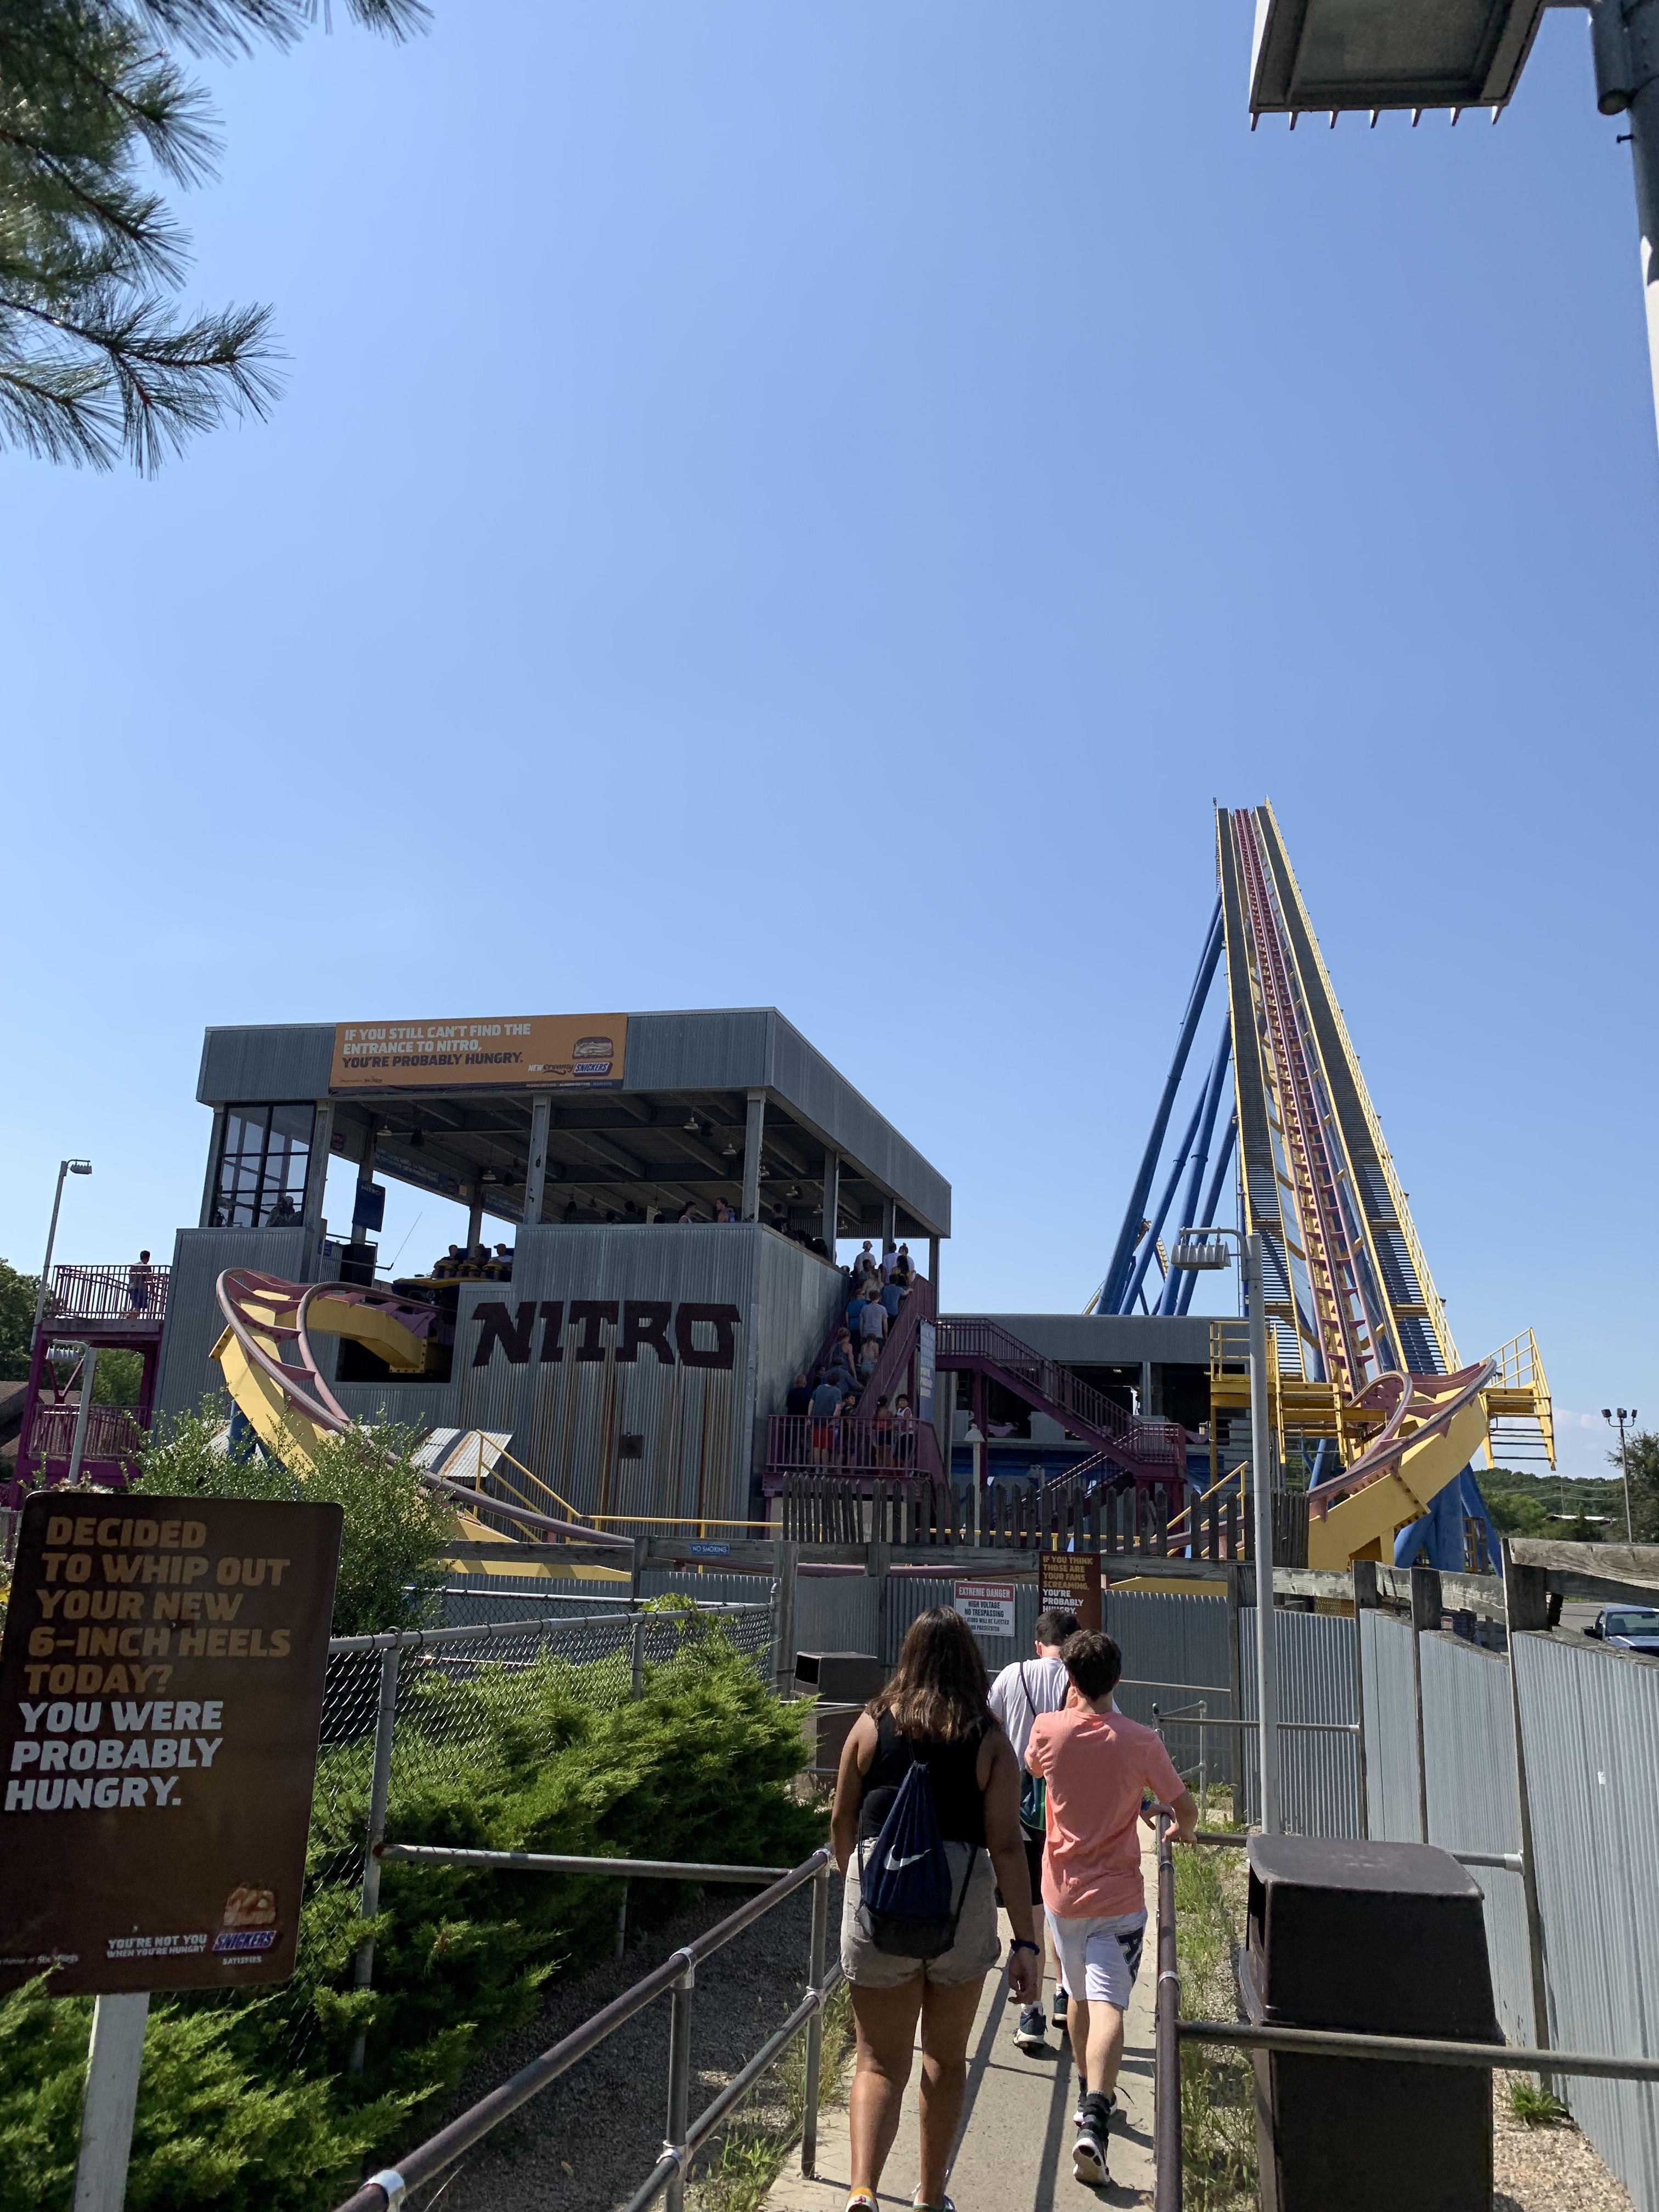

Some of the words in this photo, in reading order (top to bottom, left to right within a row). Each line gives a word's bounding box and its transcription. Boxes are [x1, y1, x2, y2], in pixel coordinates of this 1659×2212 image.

[345, 1029, 357, 1041] IF
[359, 1029, 386, 1040] YOU
[389, 1027, 424, 1040] STILL
[427, 1026, 467, 1038] CAN'T
[470, 1024, 501, 1036] FIND
[504, 1023, 531, 1035] THE
[343, 1042, 413, 1054] ENTRANCE
[417, 1041, 434, 1052] TO
[437, 1039, 483, 1052] NITRO,
[342, 1056, 390, 1068] YOU'RE
[392, 1054, 464, 1066] PROBABLY
[465, 1052, 523, 1065] HUNGRY.
[575, 1062, 609, 1073] SNICKERS
[472, 1300, 741, 1370] NITRO
[46, 1516, 207, 1549] DECIDED
[1043, 1564, 1068, 1572] THOSE
[1069, 1556, 1093, 1565] THINK
[41, 1553, 92, 1583] TO
[102, 1554, 209, 1584] WHIP
[217, 1558, 291, 1587] OUT
[1043, 1572, 1064, 1580] YOUR
[959, 1587, 985, 1596] EXTREME
[986, 1588, 1010, 1598] DANGER
[1042, 1588, 1071, 1598] YOU'RE
[1043, 1581, 1090, 1590] SCREAMING,
[36, 1590, 145, 1620] YOUR
[154, 1592, 244, 1621] NEW
[980, 1601, 1000, 1609] VOLTAGE
[1042, 1597, 1084, 1606] PROBABLY
[972, 1609, 1004, 1617] TRESPASSING
[28, 1627, 171, 1657] 6-INCH
[179, 1628, 291, 1657] HEELS
[24, 1664, 173, 1695] TODAY?
[18, 1701, 101, 1733] YOU
[111, 1701, 224, 1731] WERE
[10, 1737, 223, 1772] PROBABLY
[4, 1776, 182, 1810] HUNGRY.
[108, 1937, 152, 1949] YOU'RE
[154, 1935, 180, 1948] NOT
[183, 1934, 207, 1945] YOU
[106, 1948, 134, 1958] WHEN
[137, 1947, 167, 1956] YOU'RE
[222, 1955, 262, 1965] SATISFIES
